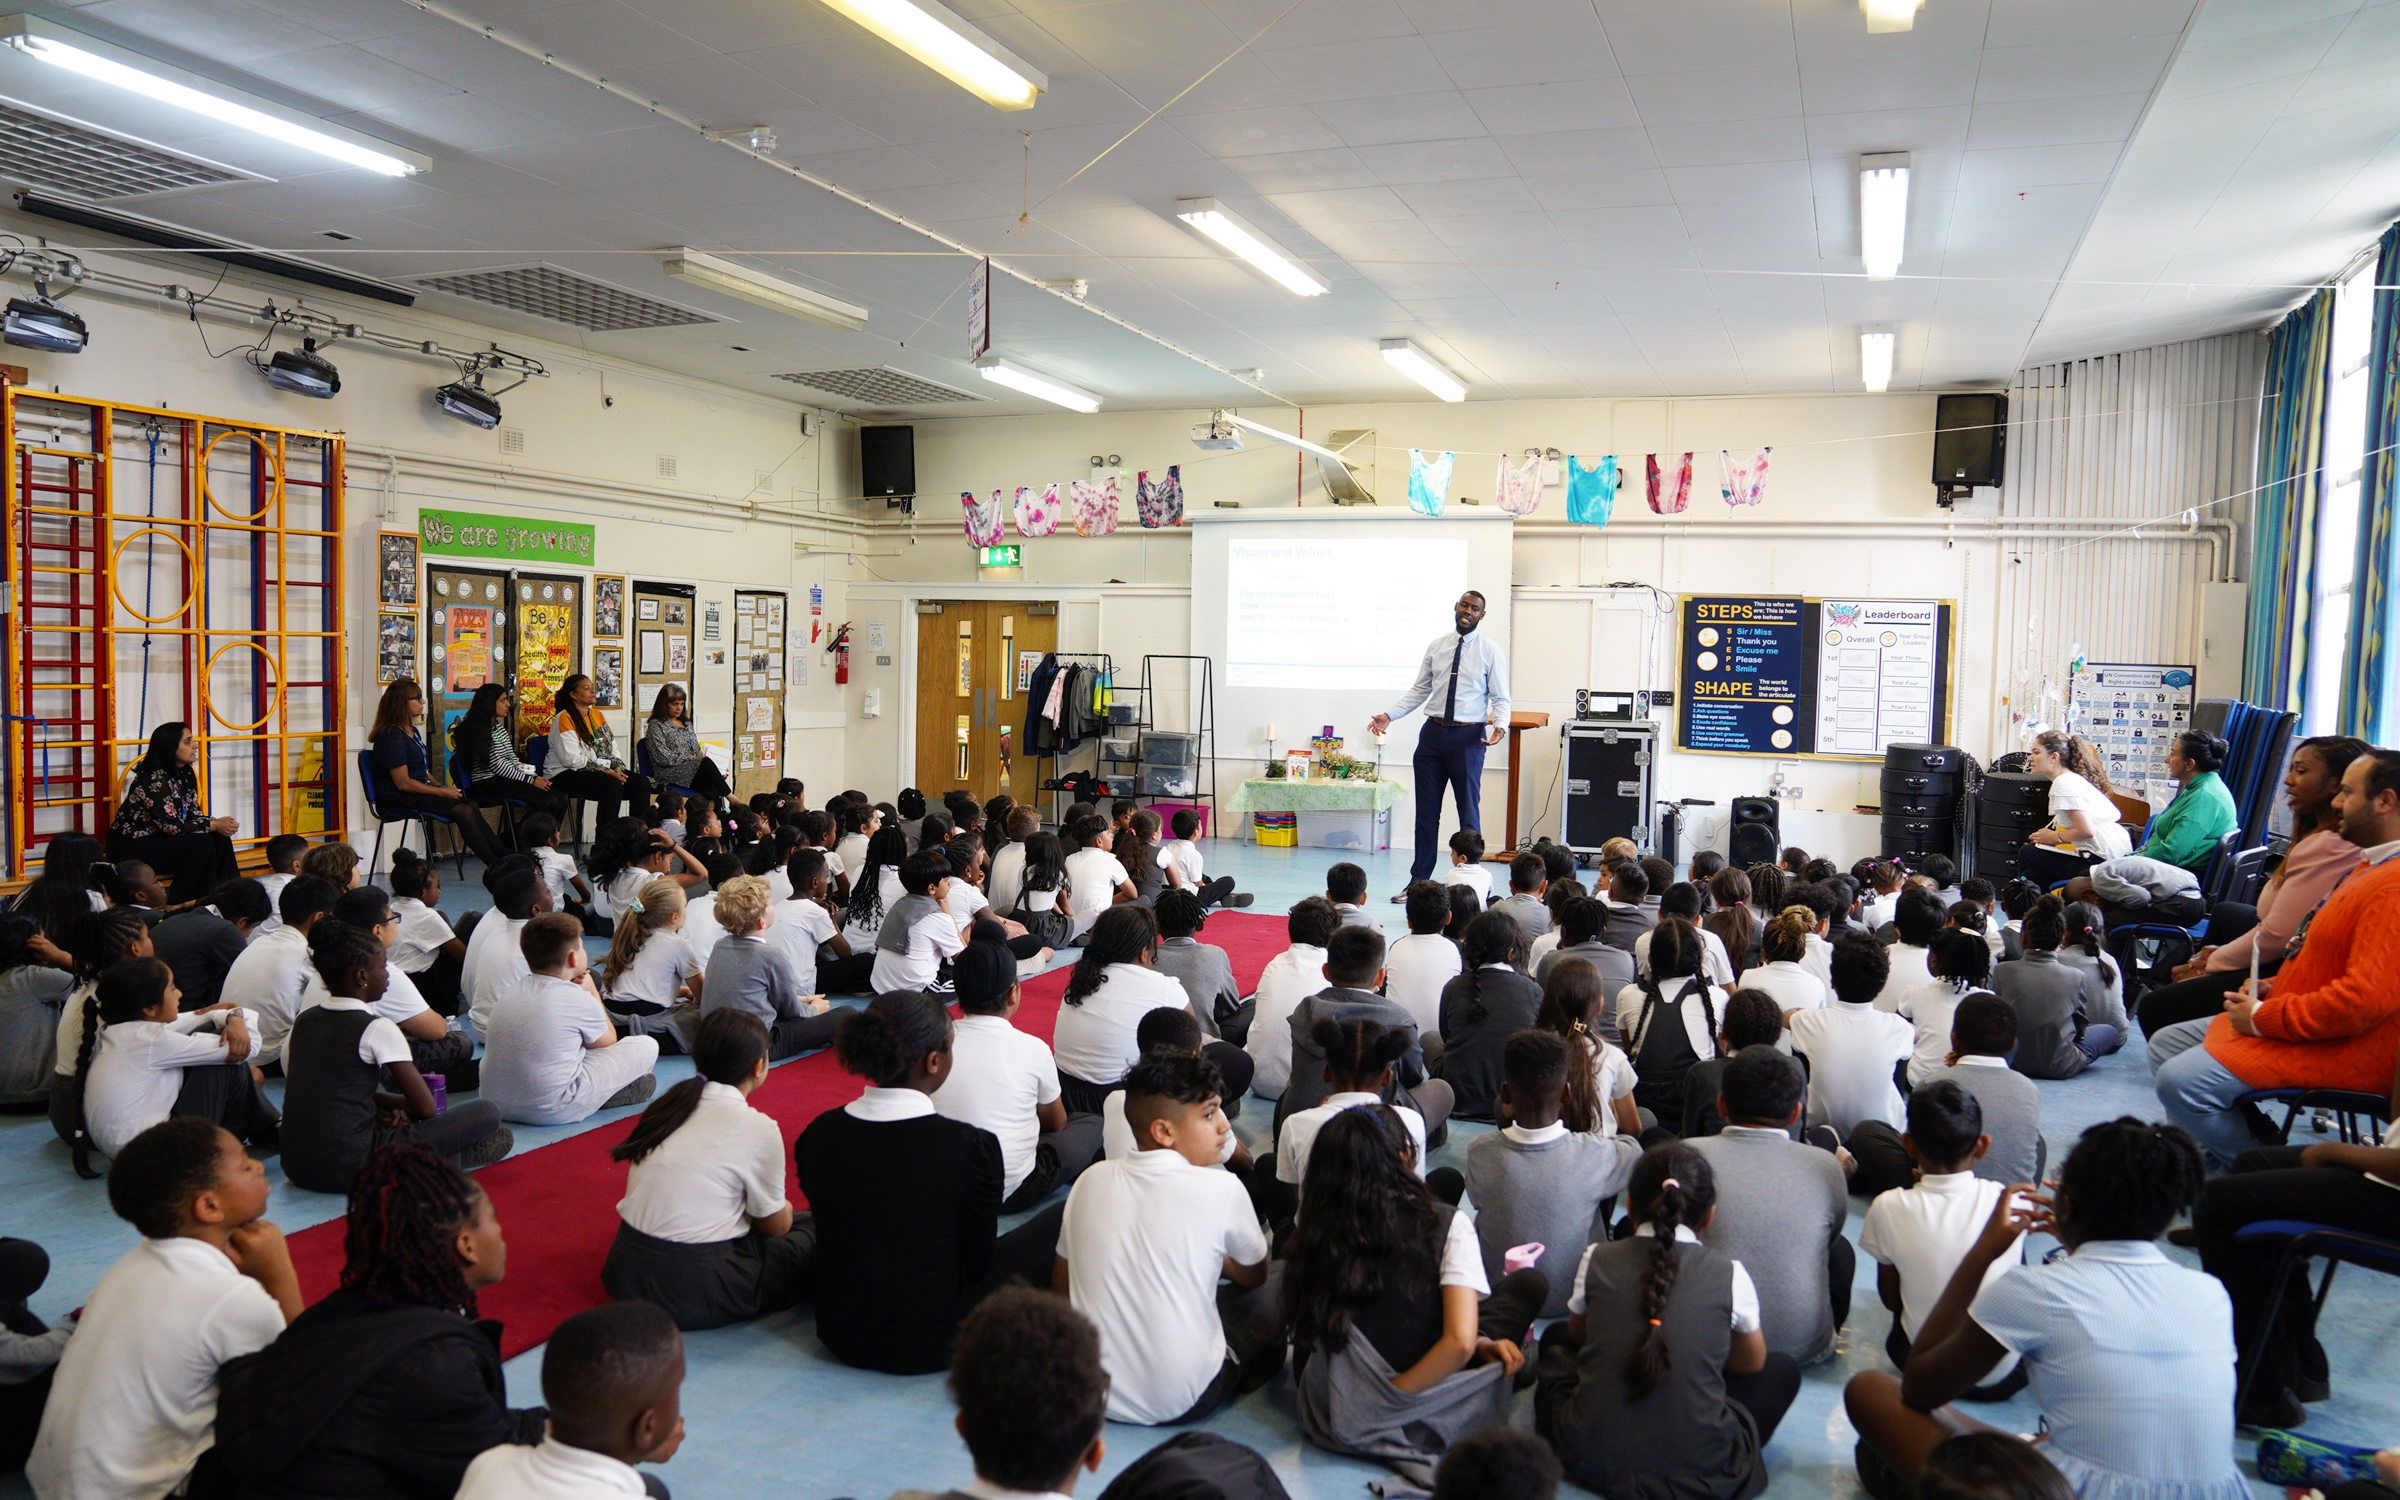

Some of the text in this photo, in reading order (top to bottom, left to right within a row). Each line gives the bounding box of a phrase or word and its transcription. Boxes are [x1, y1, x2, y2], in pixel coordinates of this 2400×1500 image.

[420, 513, 591, 558] We are growing
[1234, 547, 1333, 558] Vision and Values
[1240, 589, 1255, 598] For
[1256, 590, 1267, 598] all
[1268, 590, 1303, 598] children
[1240, 601, 1260, 609] their
[530, 609, 546, 624] Be
[1697, 604, 1753, 619] STEPS
[1865, 610, 1931, 620] Leaderboard
[454, 608, 486, 628] 2023
[1240, 613, 1256, 621] and
[1308, 615, 1341, 623] achieve
[1736, 637, 1761, 645] Thank
[1846, 635, 1875, 643] Overall
[524, 651, 548, 660] healthy
[550, 647, 566, 655] happy
[1694, 681, 1753, 696] SHAPE
[525, 706, 548, 715] helpful
